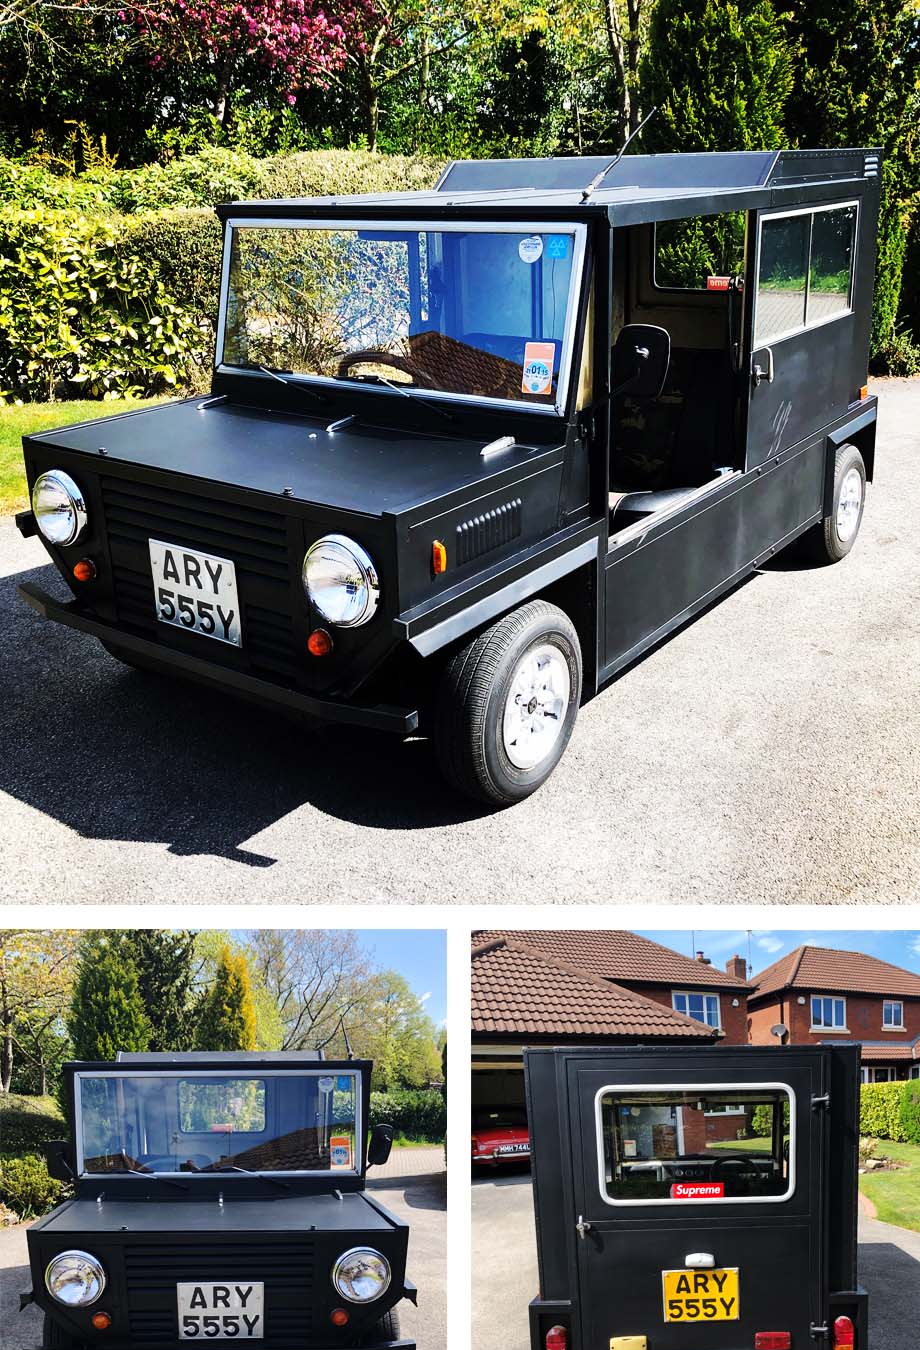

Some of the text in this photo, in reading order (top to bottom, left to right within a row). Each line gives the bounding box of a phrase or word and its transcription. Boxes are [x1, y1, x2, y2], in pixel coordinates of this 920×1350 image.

[163, 549, 223, 595] ARY
[158, 587, 235, 640] 555Y
[676, 1184, 721, 1198] Supreme
[676, 1273, 728, 1294] ARY
[189, 1286, 253, 1309] ARY
[668, 1297, 735, 1319] 555Y
[183, 1314, 260, 1337] 555Y
